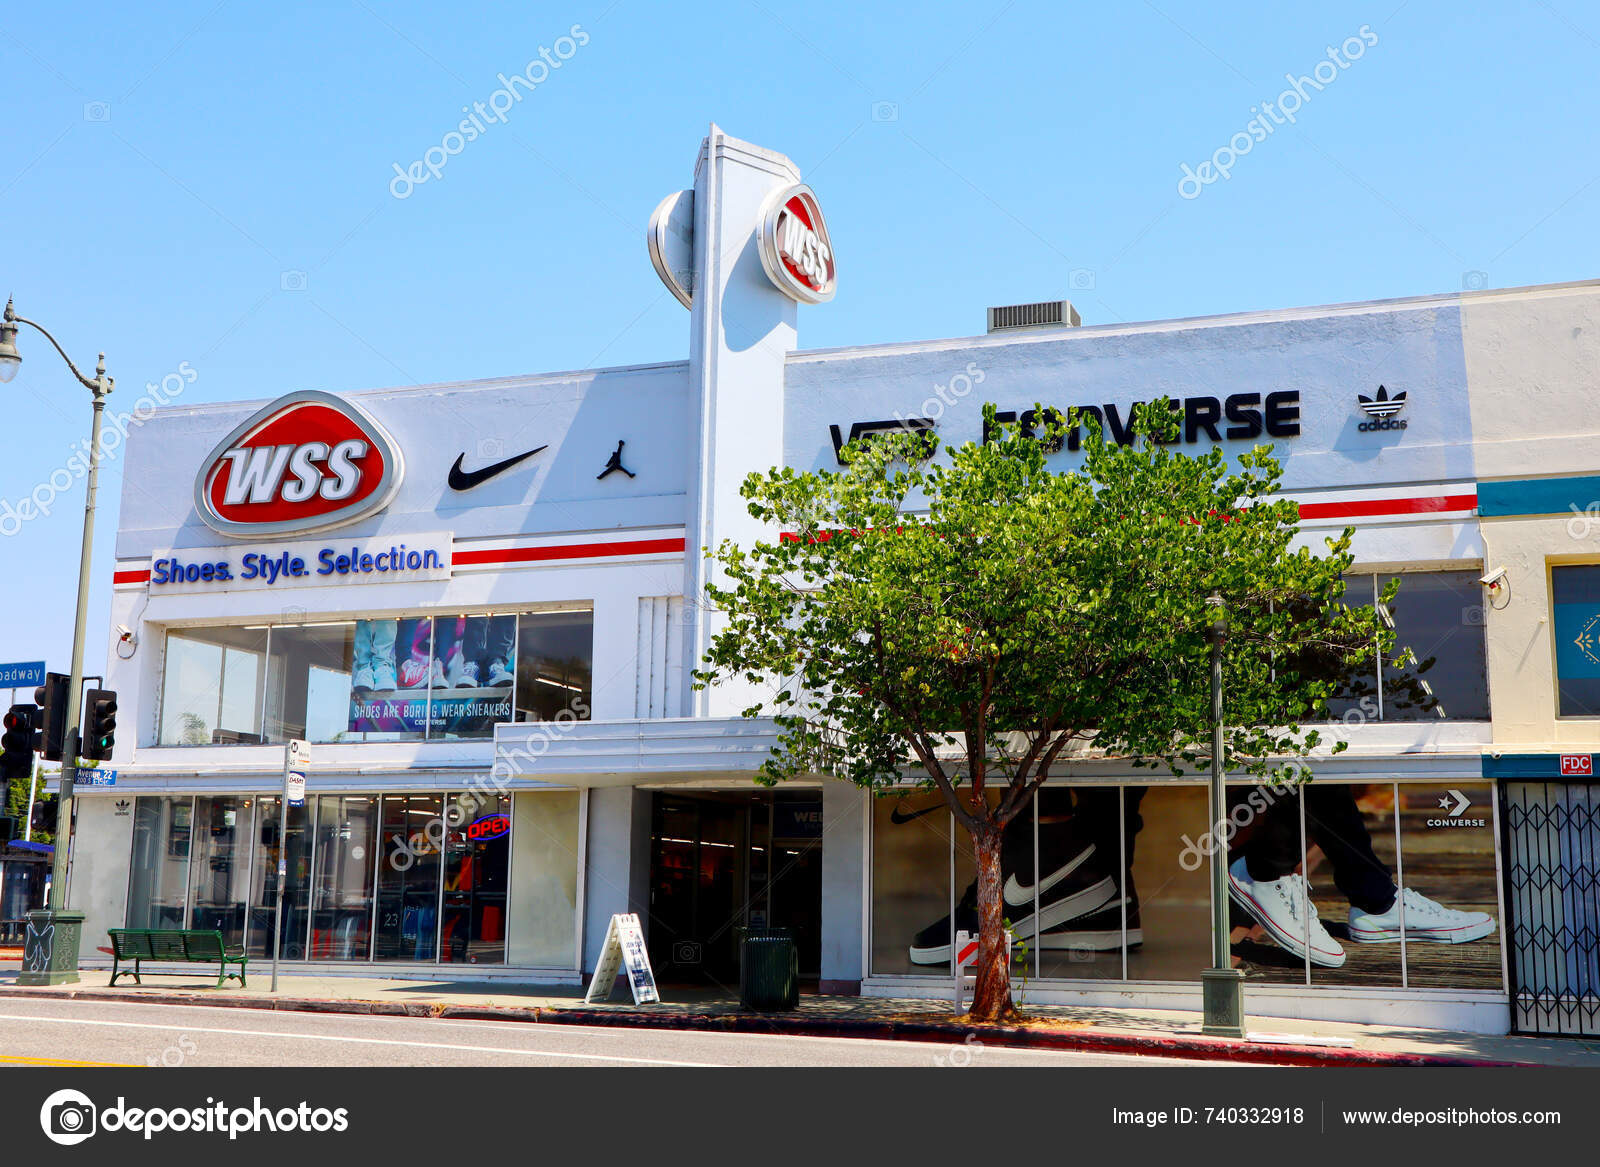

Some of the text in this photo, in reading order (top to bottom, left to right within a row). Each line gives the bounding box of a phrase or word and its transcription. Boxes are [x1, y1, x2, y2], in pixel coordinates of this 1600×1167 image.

[783, 206, 830, 285] WSS
[1358, 419, 1408, 432] adidas
[220, 439, 370, 506] WSS
[152, 544, 444, 585] Shoes. Style. Selection.
[354, 702, 511, 718] SHOES ARE BORIG WEAR SNEAKERS
[1562, 756, 1589, 770] FDC
[77, 769, 113, 780] Avenue 22
[1426, 819, 1485, 827] CONVERSE
[384, 912, 398, 928] 23
